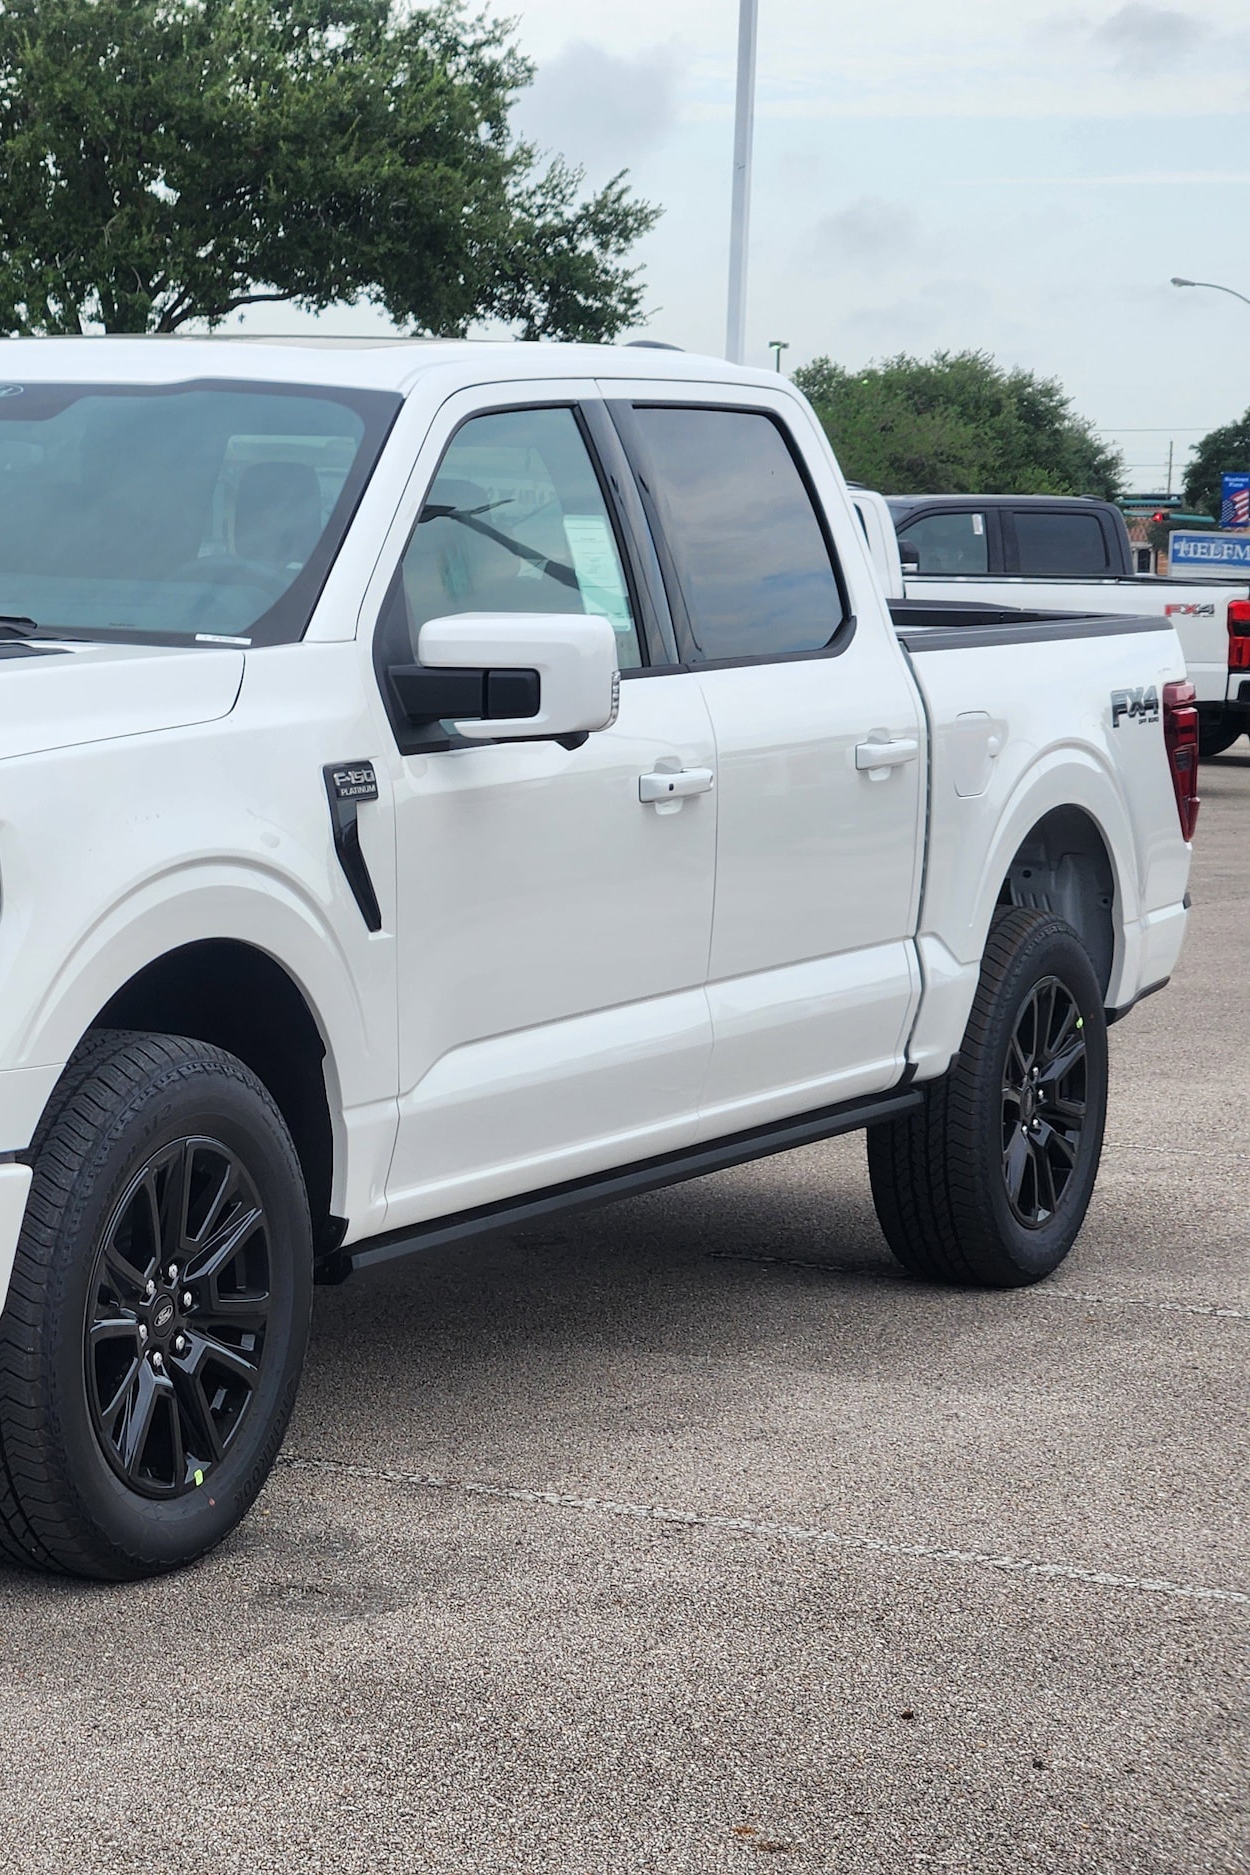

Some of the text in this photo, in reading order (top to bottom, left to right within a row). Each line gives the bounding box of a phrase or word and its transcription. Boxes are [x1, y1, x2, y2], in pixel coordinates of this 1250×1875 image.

[1165, 603, 1215, 617] FX4
[1110, 685, 1159, 728] FX4
[333, 769, 376, 786] F-150
[341, 784, 376, 796] PLATINUM
